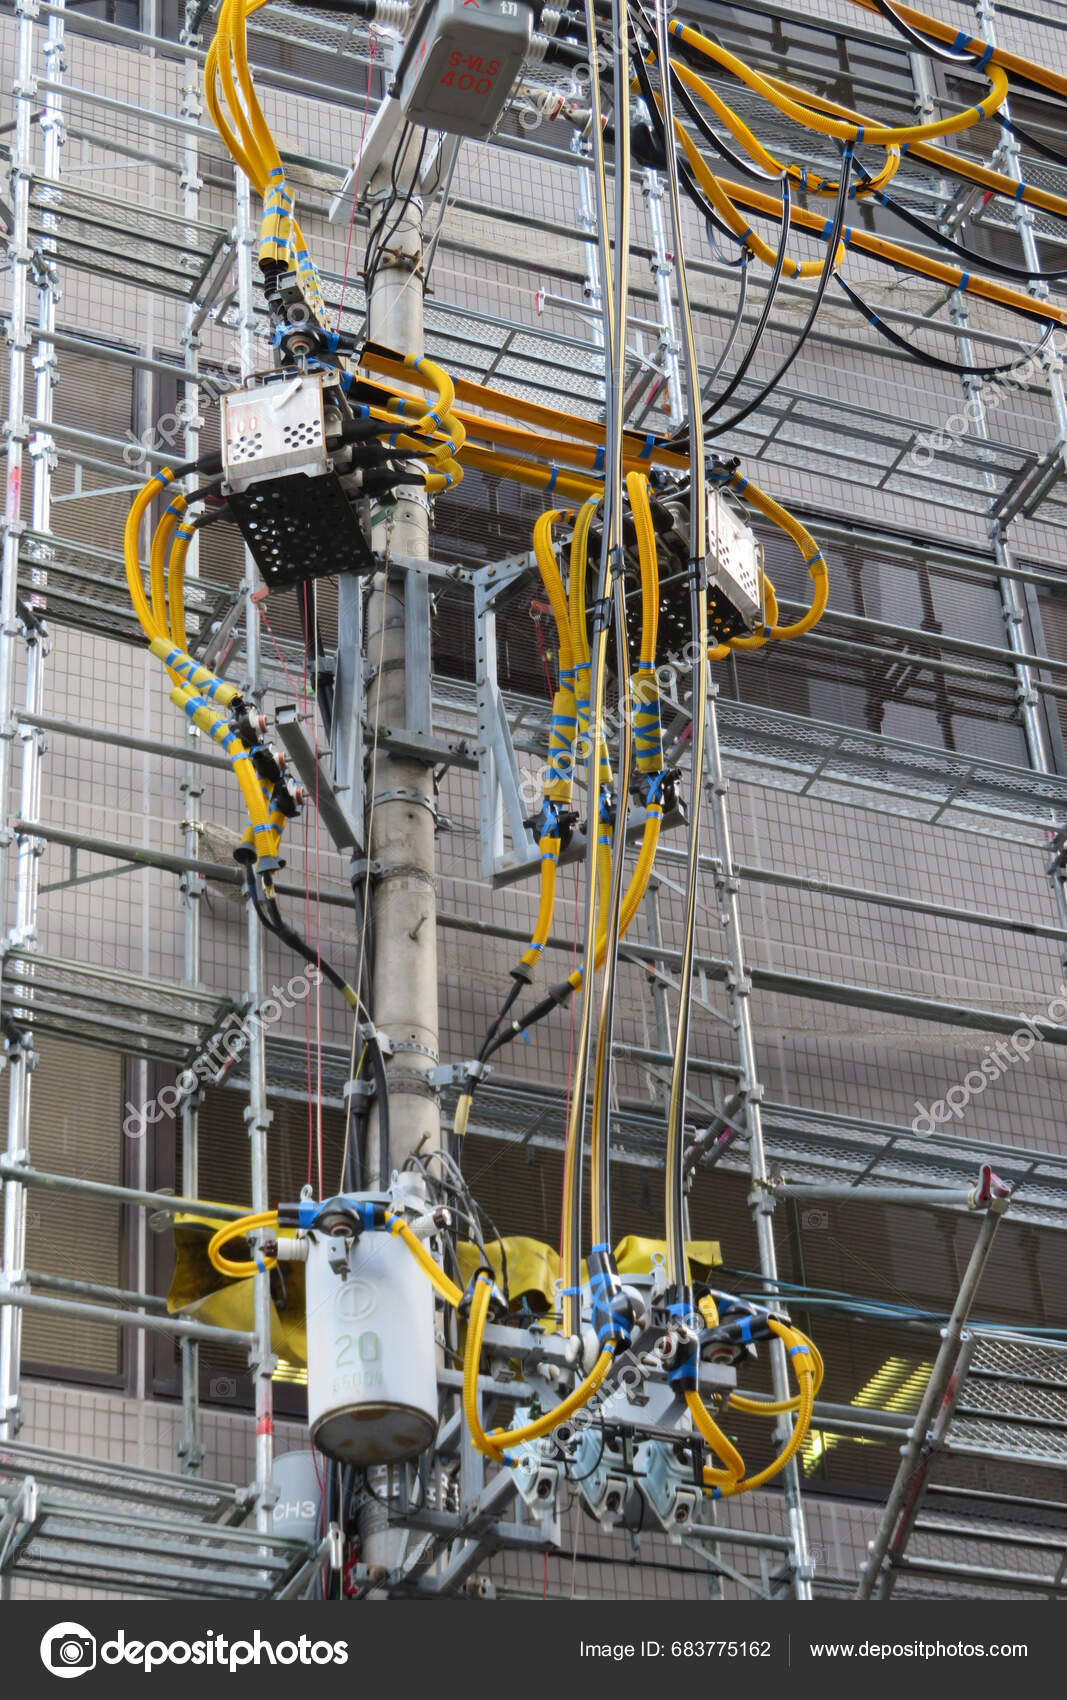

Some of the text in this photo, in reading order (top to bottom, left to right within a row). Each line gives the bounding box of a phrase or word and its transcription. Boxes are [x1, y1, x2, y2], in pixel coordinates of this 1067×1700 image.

[448, 50, 501, 76] S-VLS
[440, 70, 492, 95] 400
[335, 1331, 379, 1368] 20
[272, 1500, 316, 1521] CH3
